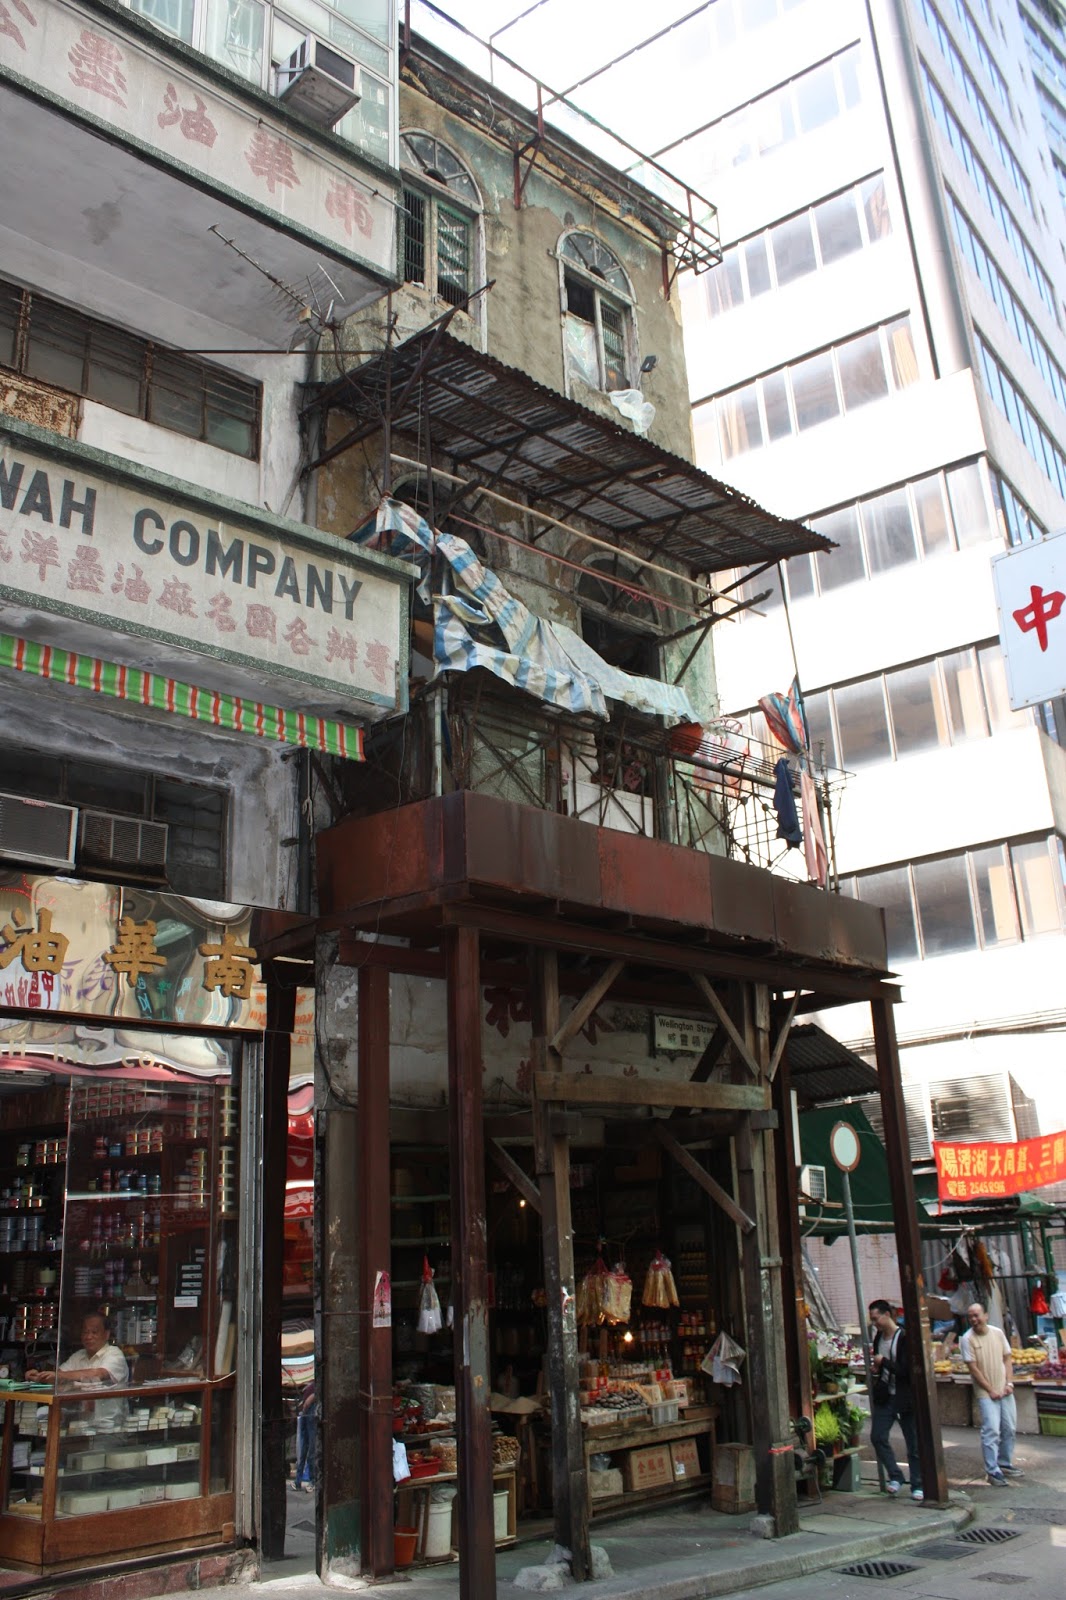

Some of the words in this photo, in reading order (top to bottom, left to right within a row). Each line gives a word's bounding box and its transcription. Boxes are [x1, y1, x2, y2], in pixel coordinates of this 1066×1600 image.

[134, 507, 363, 621] COMPANY
[1012, 585, 1066, 652] 中
[658, 1017, 694, 1032] Wellington
[696, 1023, 716, 1033] Stree
